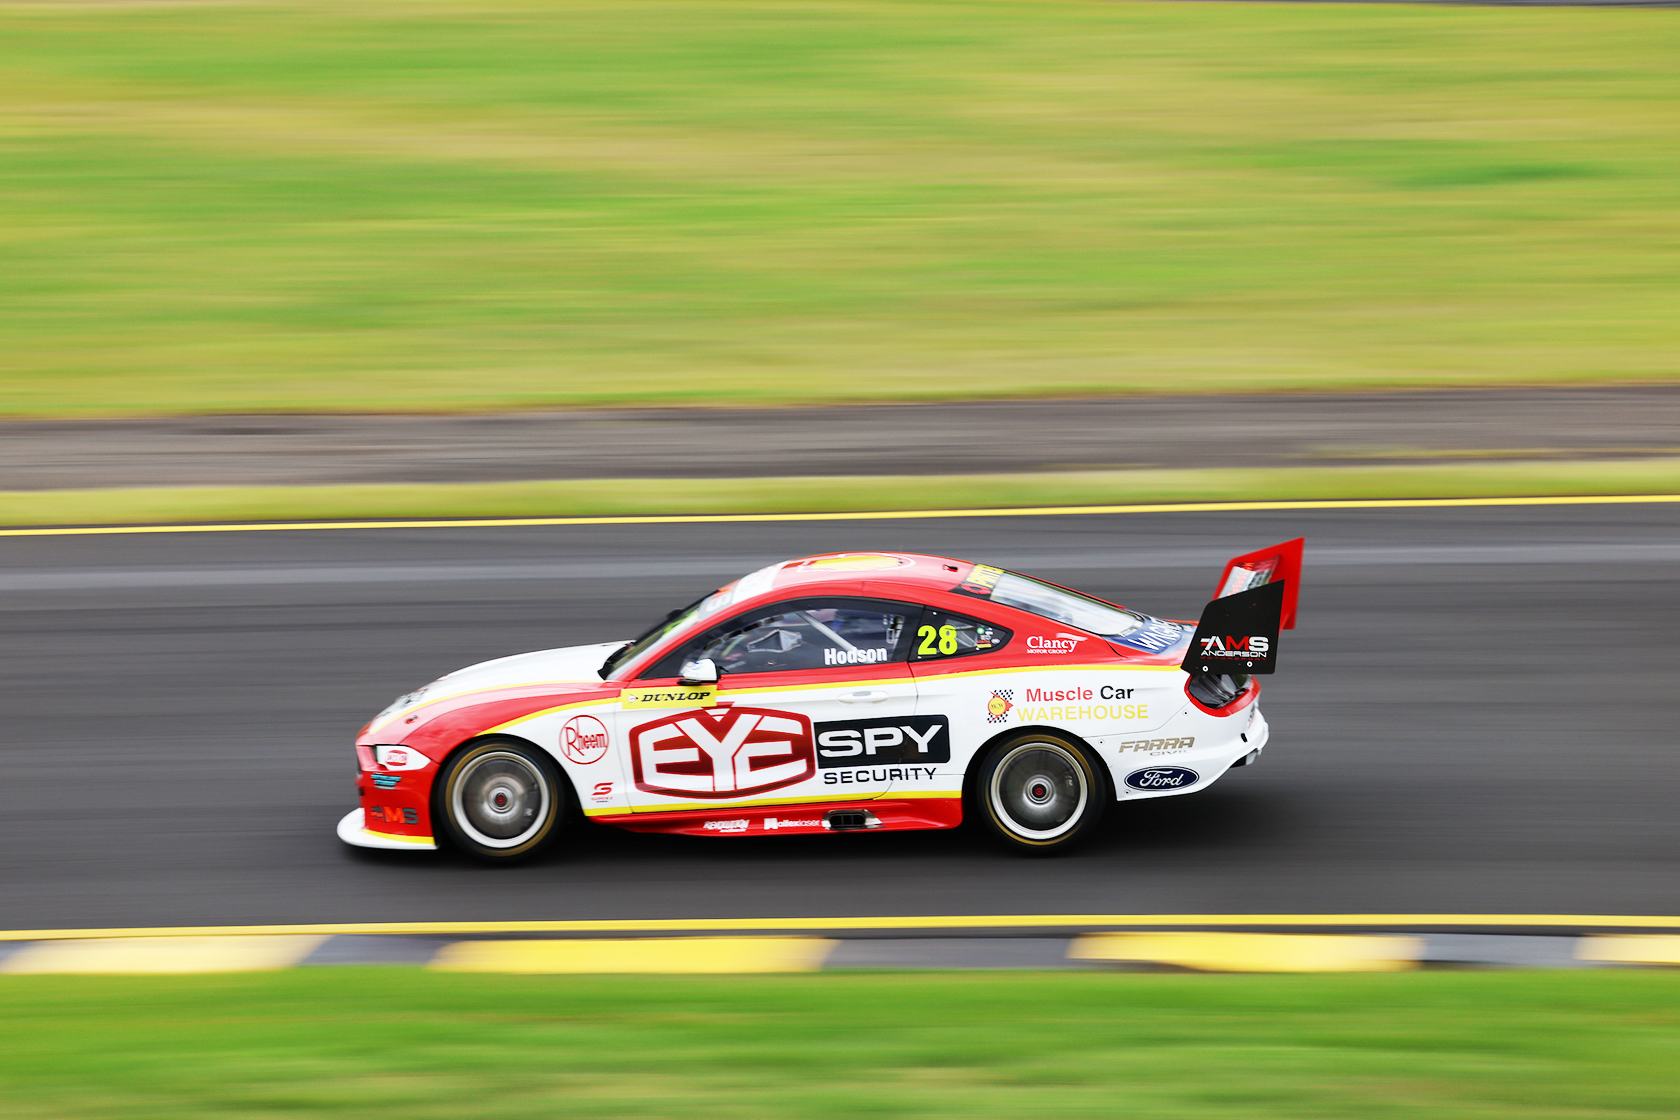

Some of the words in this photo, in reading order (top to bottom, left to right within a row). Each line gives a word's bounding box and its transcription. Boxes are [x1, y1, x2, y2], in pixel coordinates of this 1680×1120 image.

[917, 625, 959, 656] 28
[1026, 635, 1078, 653] Clancy
[824, 648, 888, 665] Hodson
[1200, 650, 1267, 658] ANDERSON
[641, 692, 711, 702] DUNLOP
[1026, 687, 1093, 702] Muscle
[1100, 685, 1135, 700] Car
[1016, 704, 1149, 722] WAREHOUSE
[563, 718, 608, 756] Rheem
[638, 713, 808, 792] EYE
[817, 724, 943, 758] SPY
[823, 767, 937, 785] SECURITY
[1139, 770, 1185, 787] Ford
